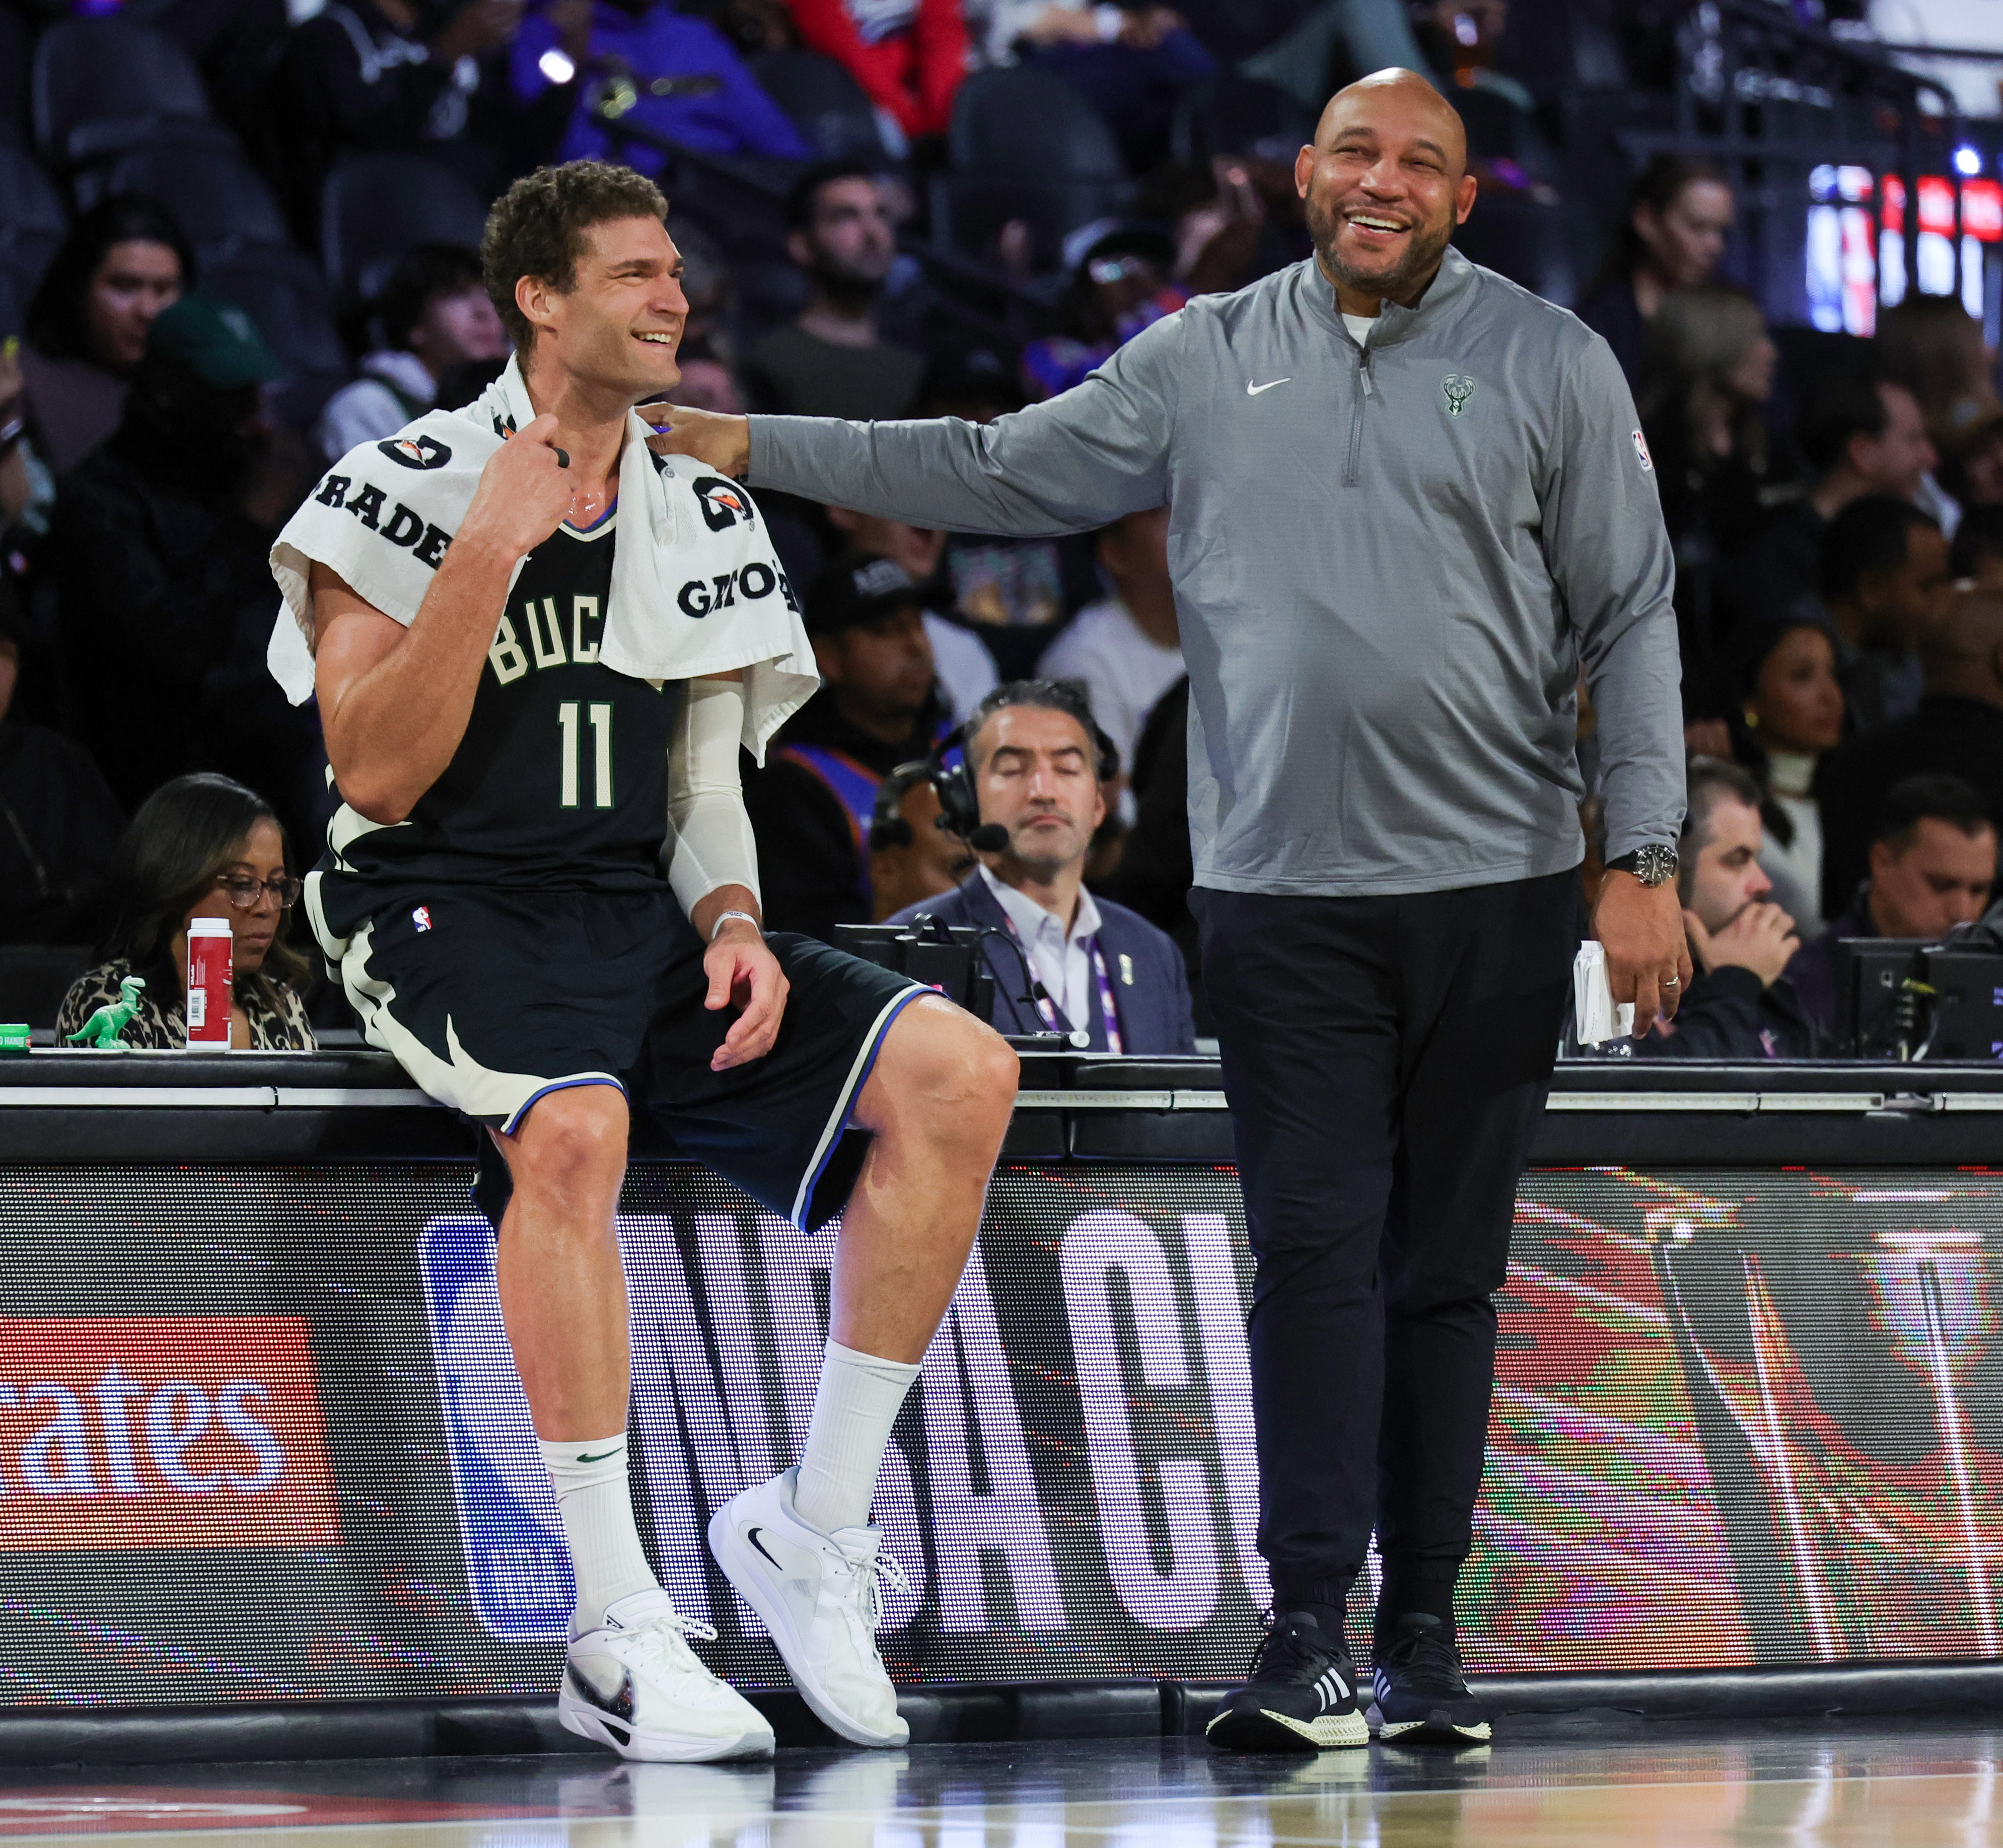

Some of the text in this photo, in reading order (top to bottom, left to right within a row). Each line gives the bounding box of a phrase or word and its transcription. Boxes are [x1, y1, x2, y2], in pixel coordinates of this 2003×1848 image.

[308, 474, 454, 571] RADE
[488, 593, 601, 687] BUC
[556, 700, 614, 809] 11
